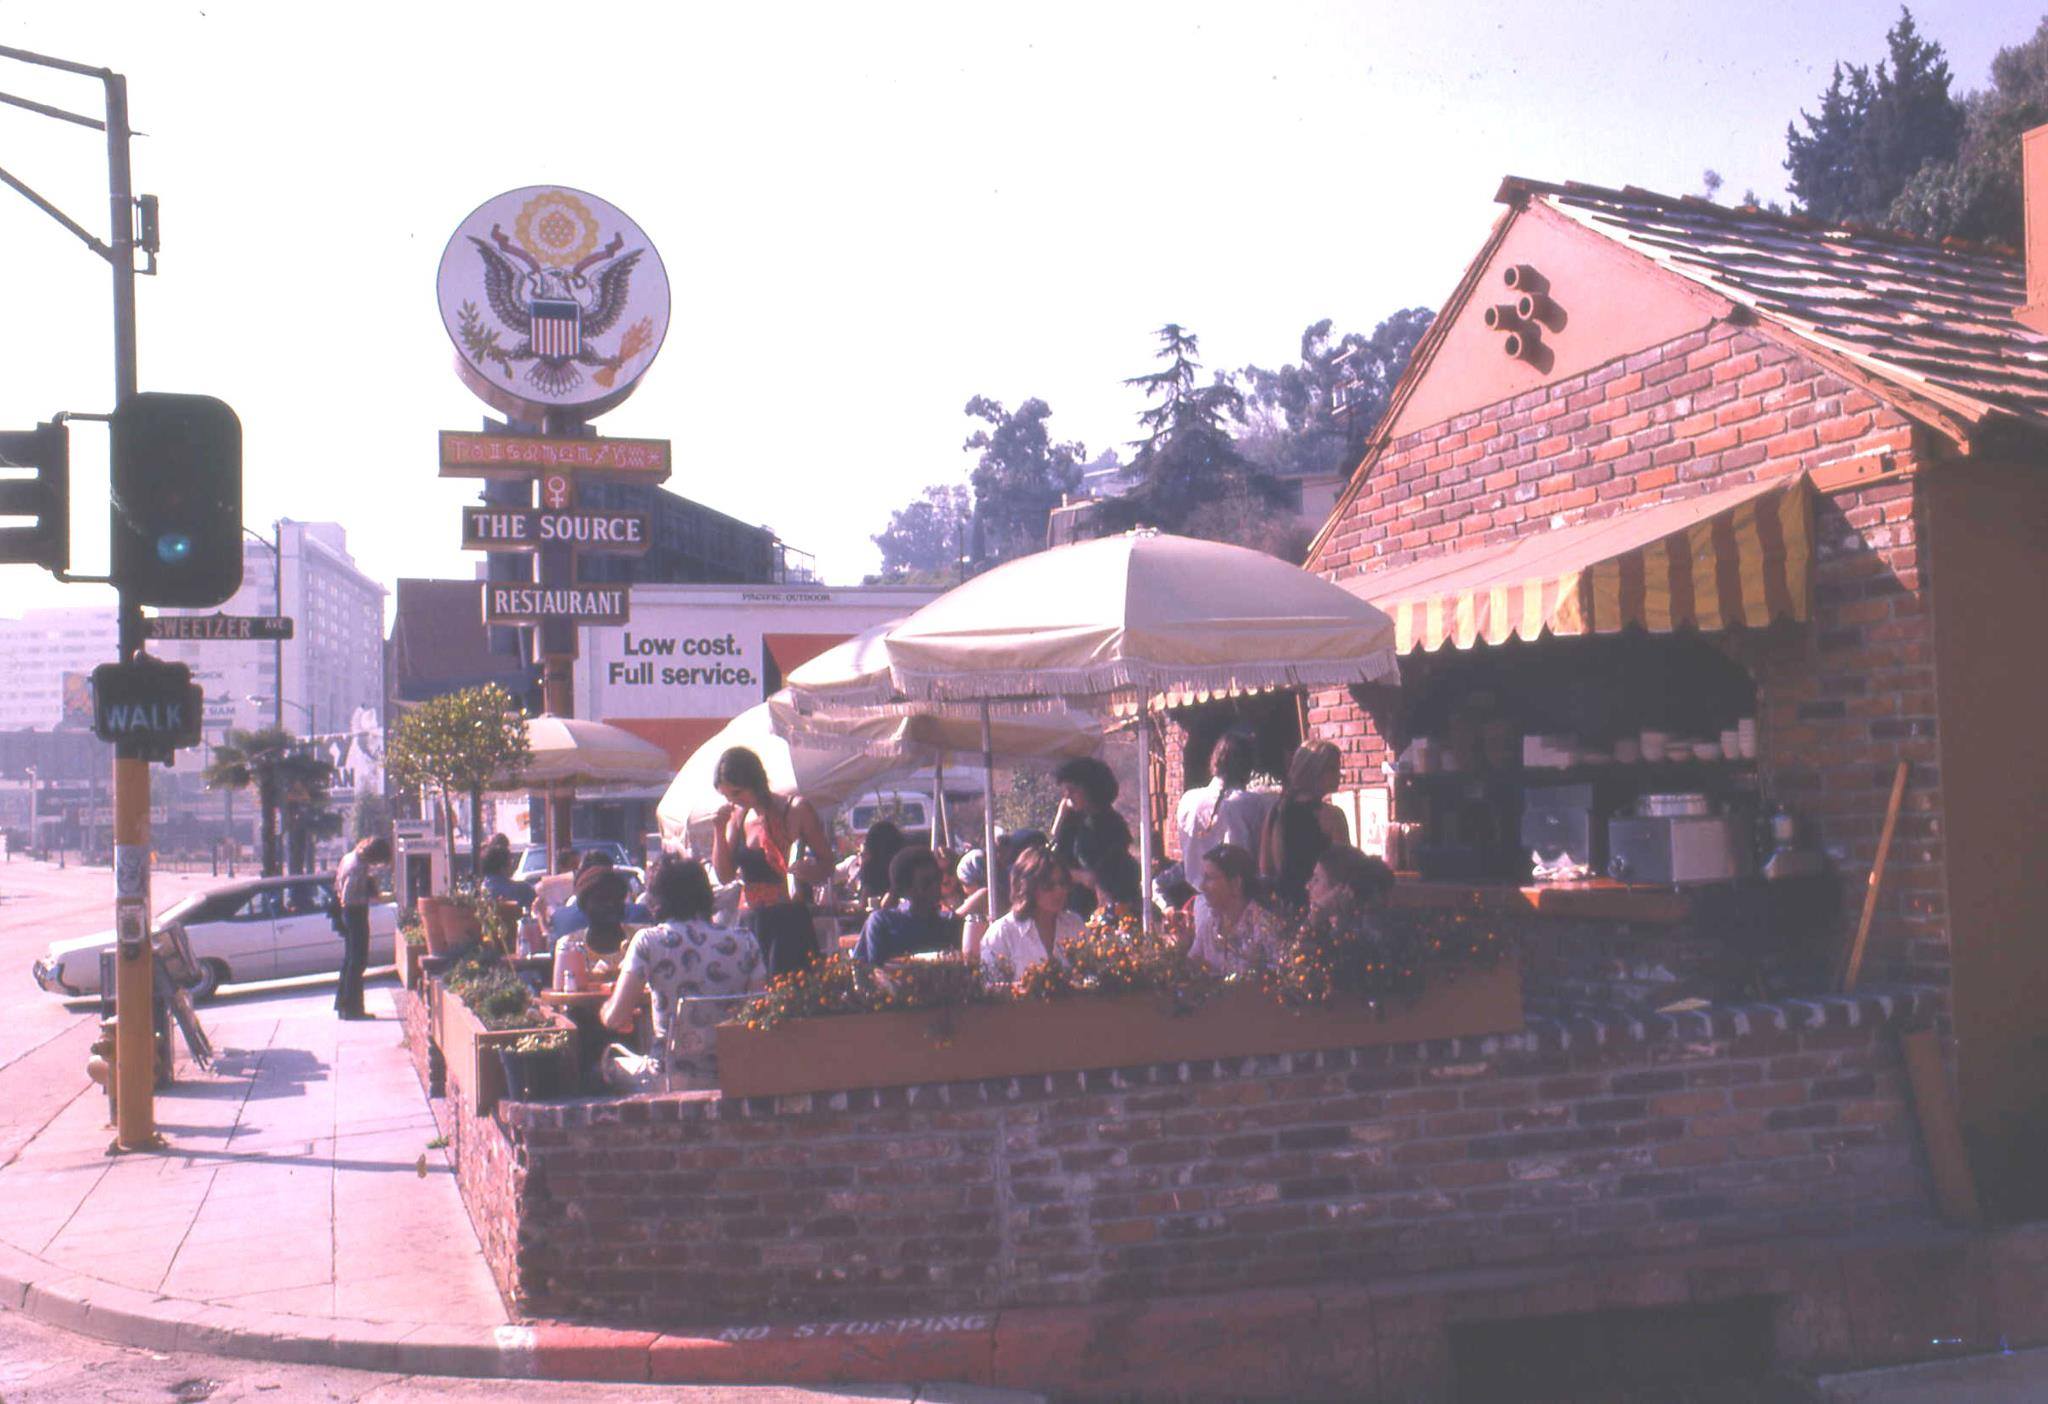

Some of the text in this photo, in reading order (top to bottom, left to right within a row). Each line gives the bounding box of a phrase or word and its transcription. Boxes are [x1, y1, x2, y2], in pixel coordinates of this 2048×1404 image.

[472, 514, 641, 542] THE SOURCE
[495, 590, 622, 614] RESTAURANT
[785, 592, 830, 602] OUTDOOR
[152, 618, 285, 638] SWEETZER AVE
[624, 632, 742, 656] Low cost.
[609, 661, 757, 686] Full service.
[103, 704, 181, 732] WALK
[719, 1314, 987, 1340] NO STOPPING
